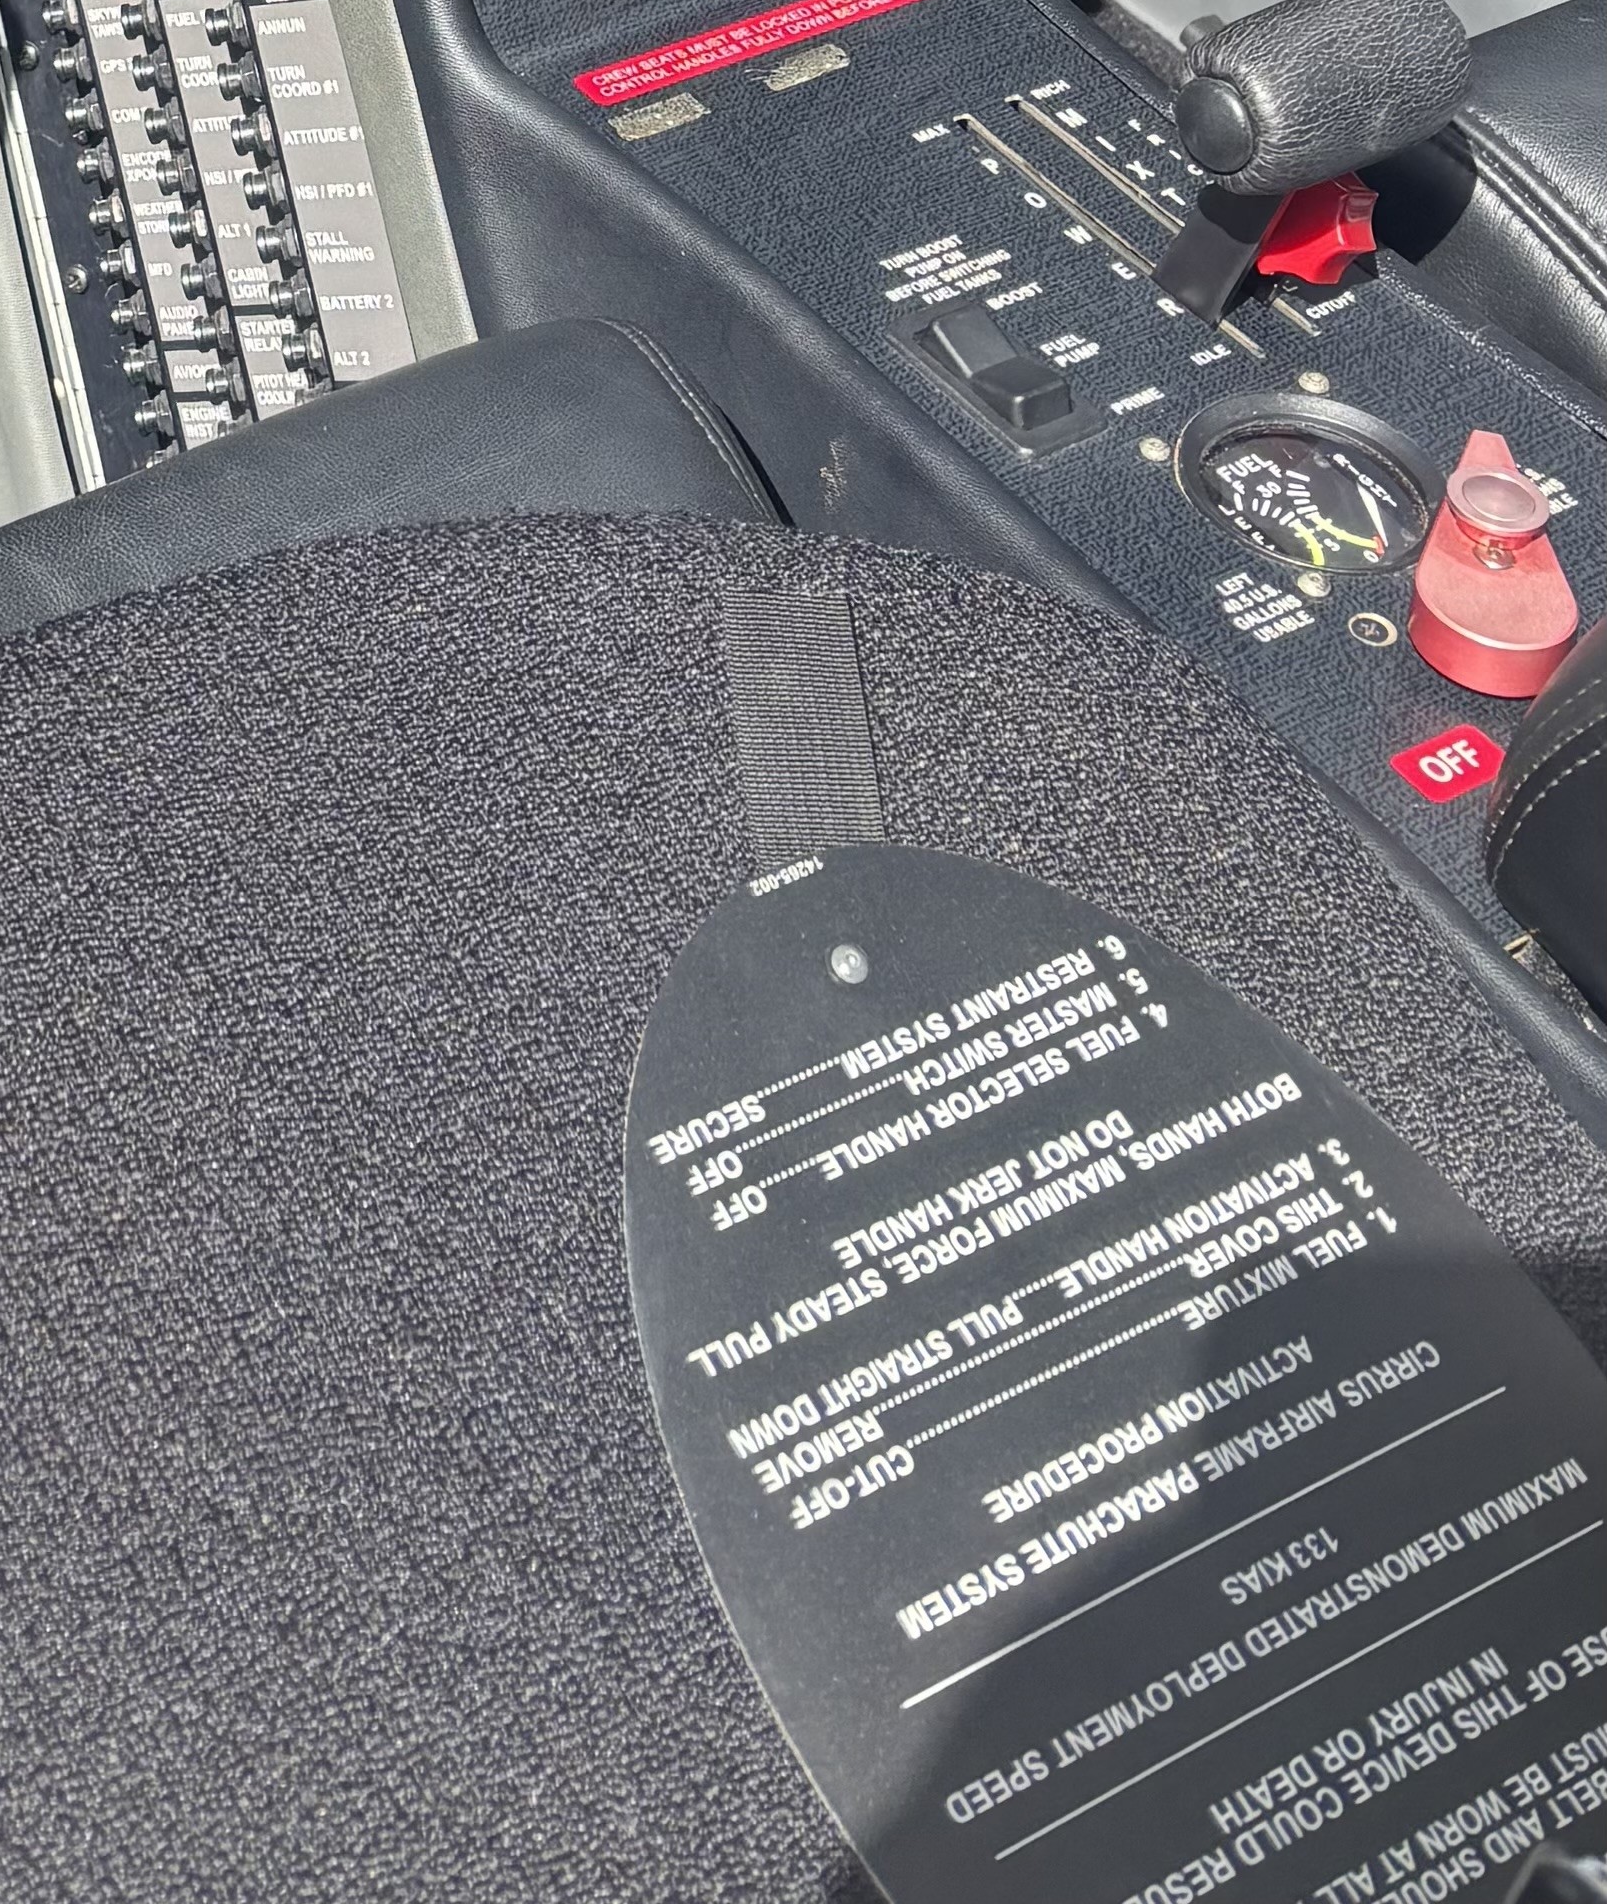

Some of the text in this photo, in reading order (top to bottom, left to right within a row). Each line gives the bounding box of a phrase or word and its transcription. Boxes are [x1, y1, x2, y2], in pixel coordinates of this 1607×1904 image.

[258, 17, 306, 35] ANNUN
[266, 64, 306, 82] TURN
[271, 80, 322, 98] COORD
[283, 127, 348, 145] ATTITUDE
[912, 123, 951, 143] MAX
[305, 230, 349, 247] STALL
[916, 234, 963, 260] BOOST
[307, 246, 375, 264] WARNING
[886, 249, 1012, 302] BEFORE SWITCHING
[320, 294, 382, 311] BATTERY
[986, 282, 1044, 310] BOOST
[1306, 290, 1356, 319] CUTOFF
[333, 351, 357, 366] ALT
[1039, 334, 1086, 357] FUEL
[1055, 343, 1101, 369] PUMP
[1190, 343, 1232, 367] IDLE
[1110, 386, 1165, 416] PRIME
[1215, 572, 1255, 596] LEFT
[1233, 594, 1303, 631] GALLONS
[1253, 610, 1315, 643] USABLE
[1418, 740, 1480, 783] OFF
[749, 847, 822, 895] 14265-002
[1097, 935, 1125, 959] 6.
[951, 948, 1094, 1030] RESTRAINT
[1119, 968, 1147, 993] 5.
[1004, 982, 1116, 1047] MASTER
[1141, 1003, 1167, 1026] 4.
[1065, 1015, 1139, 1060] FUEL
[926, 1048, 1069, 1128] SELECTOR
[1318, 1139, 1349, 1165] 3.
[832, 1110, 1133, 1268] DO NOT JERK HANDLE
[1162, 1153, 1313, 1242] ACTIVATION
[1342, 1170, 1372, 1197] 2.
[687, 1073, 1301, 1376] BOTH HANDS, MAXIMUM FORCE, STEADY PULL
[1276, 1188, 1342, 1232] THIS
[1366, 1207, 1396, 1232] 1.
[1292, 1220, 1366, 1267] FUEL
[818, 1330, 952, 1415] STRAIGHT
[728, 1394, 820, 1458] DOWN
[982, 1336, 1311, 1522] ACTIVATION PROCEDURE
[896, 1342, 1439, 1638] CIRRUS AIRFRAME PARACHUTE SYSTEM
[1221, 1527, 1337, 1604] 133 KIAS
[946, 1459, 1586, 1822] MAXIMUM DEMONSTRATED DEPLOYMENT SPEED
[1210, 1648, 1507, 1832] IN INJURY OR DEATH
